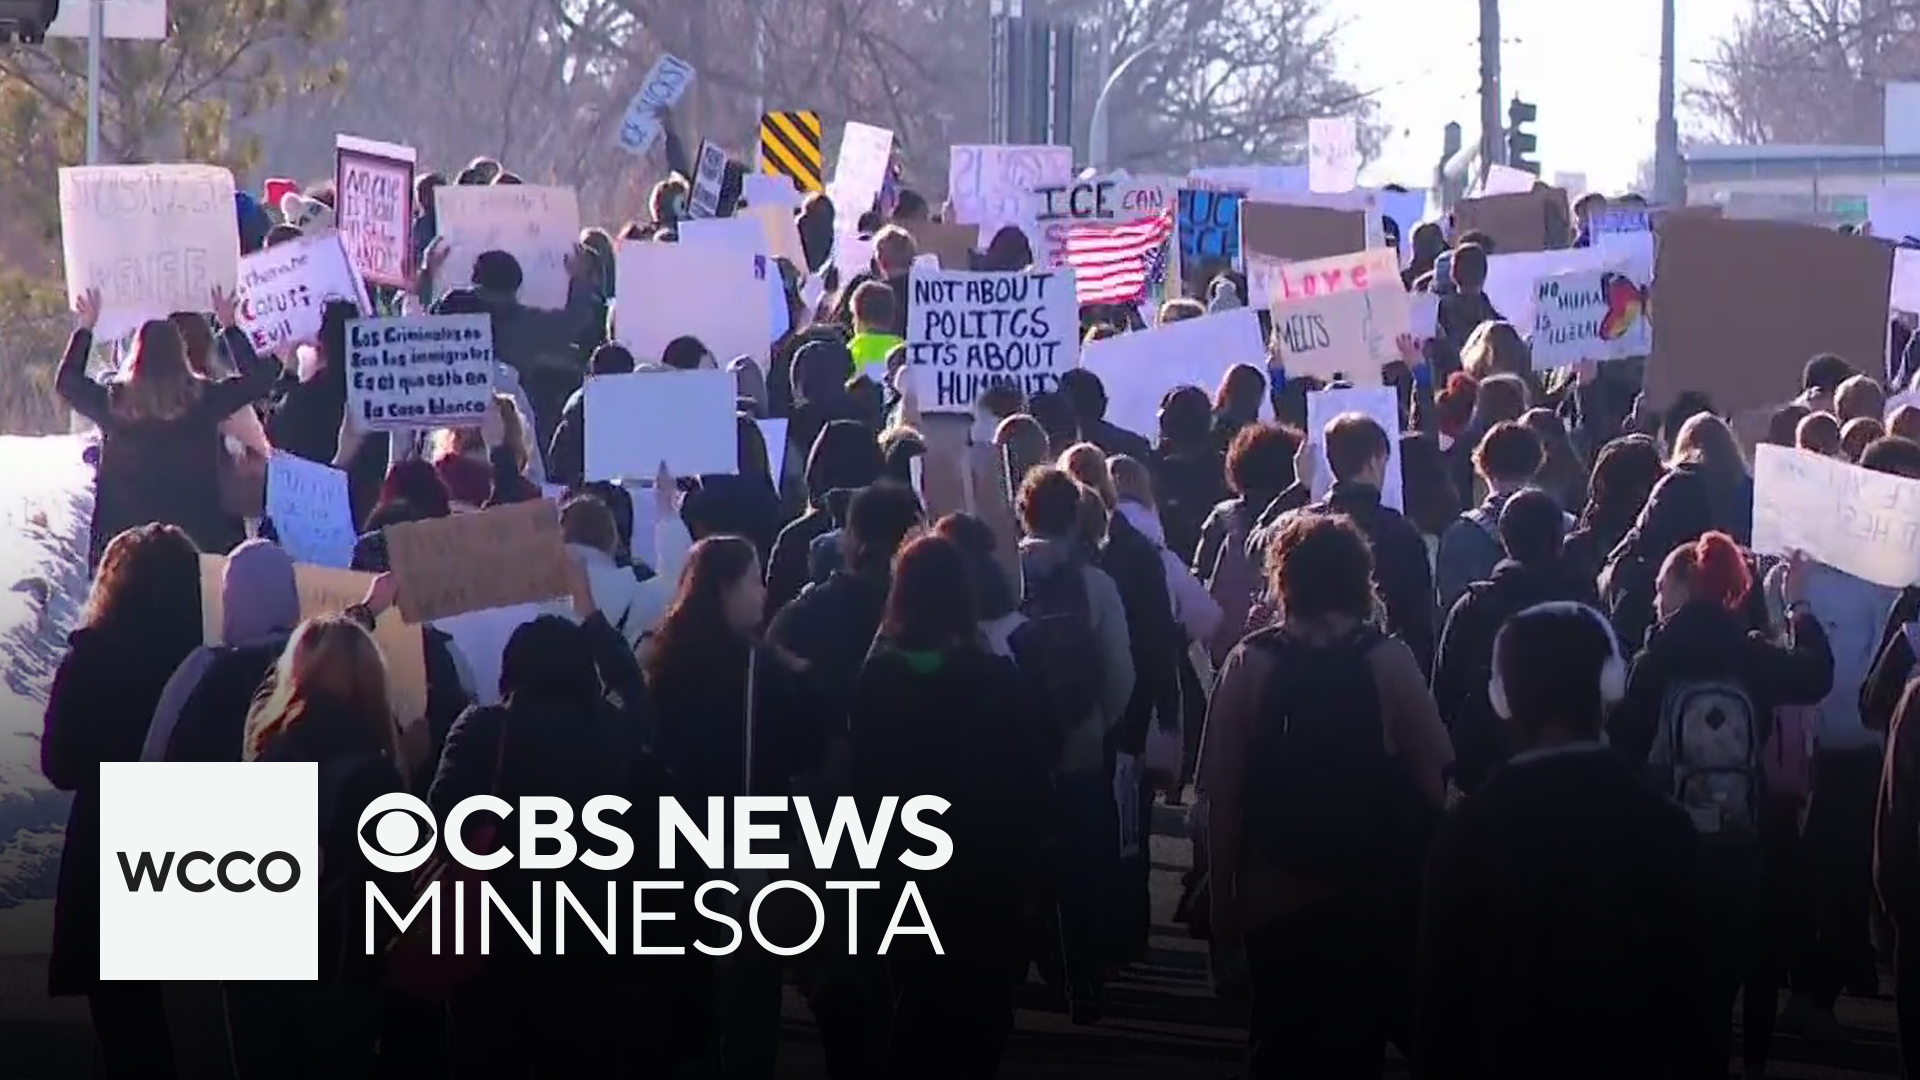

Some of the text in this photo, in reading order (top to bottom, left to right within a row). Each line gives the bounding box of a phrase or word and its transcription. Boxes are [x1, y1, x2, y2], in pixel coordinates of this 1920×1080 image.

[1034, 181, 1116, 221] ICE
[1122, 186, 1163, 211] CAN
[915, 273, 1054, 306] NOT ABOUT
[352, 325, 380, 349] Los
[925, 306, 1050, 341] POLITCS
[1276, 314, 1330, 353] MELTS
[966, 341, 1061, 372] ABOUT
